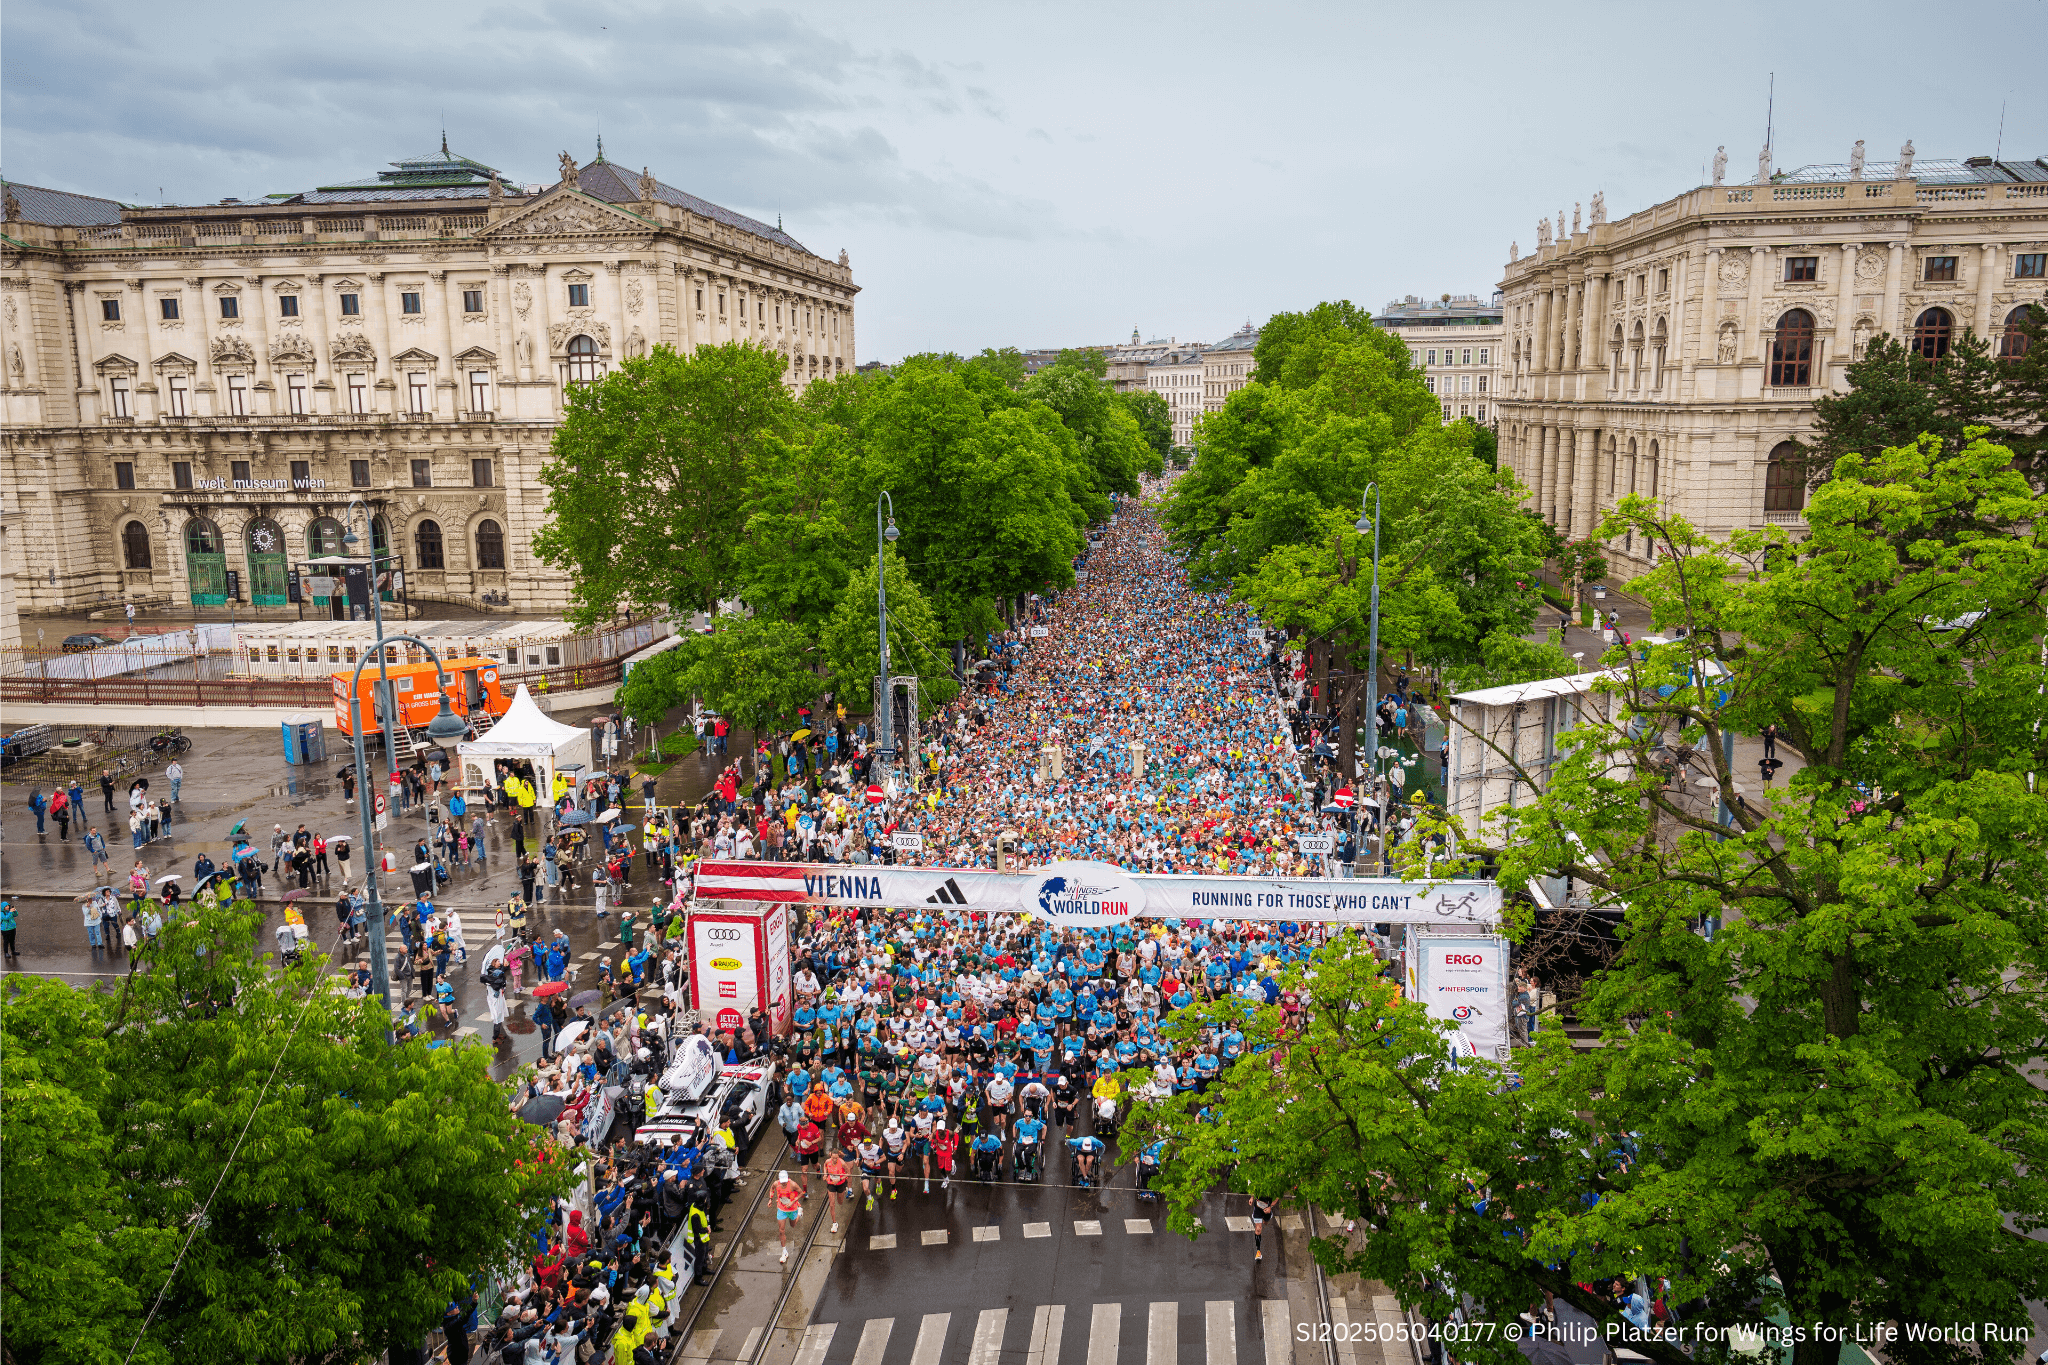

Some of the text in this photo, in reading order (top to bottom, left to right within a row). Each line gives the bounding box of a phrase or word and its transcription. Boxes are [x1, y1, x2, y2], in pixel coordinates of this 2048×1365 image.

[199, 475, 325, 488] welt museum wien
[804, 874, 882, 899] VIENNA
[1192, 891, 1412, 910] RUNNING FOR THOSE WHO CAN'T
[1445, 954, 1483, 965] ERGO
[720, 1014, 739, 1023] JETZT
